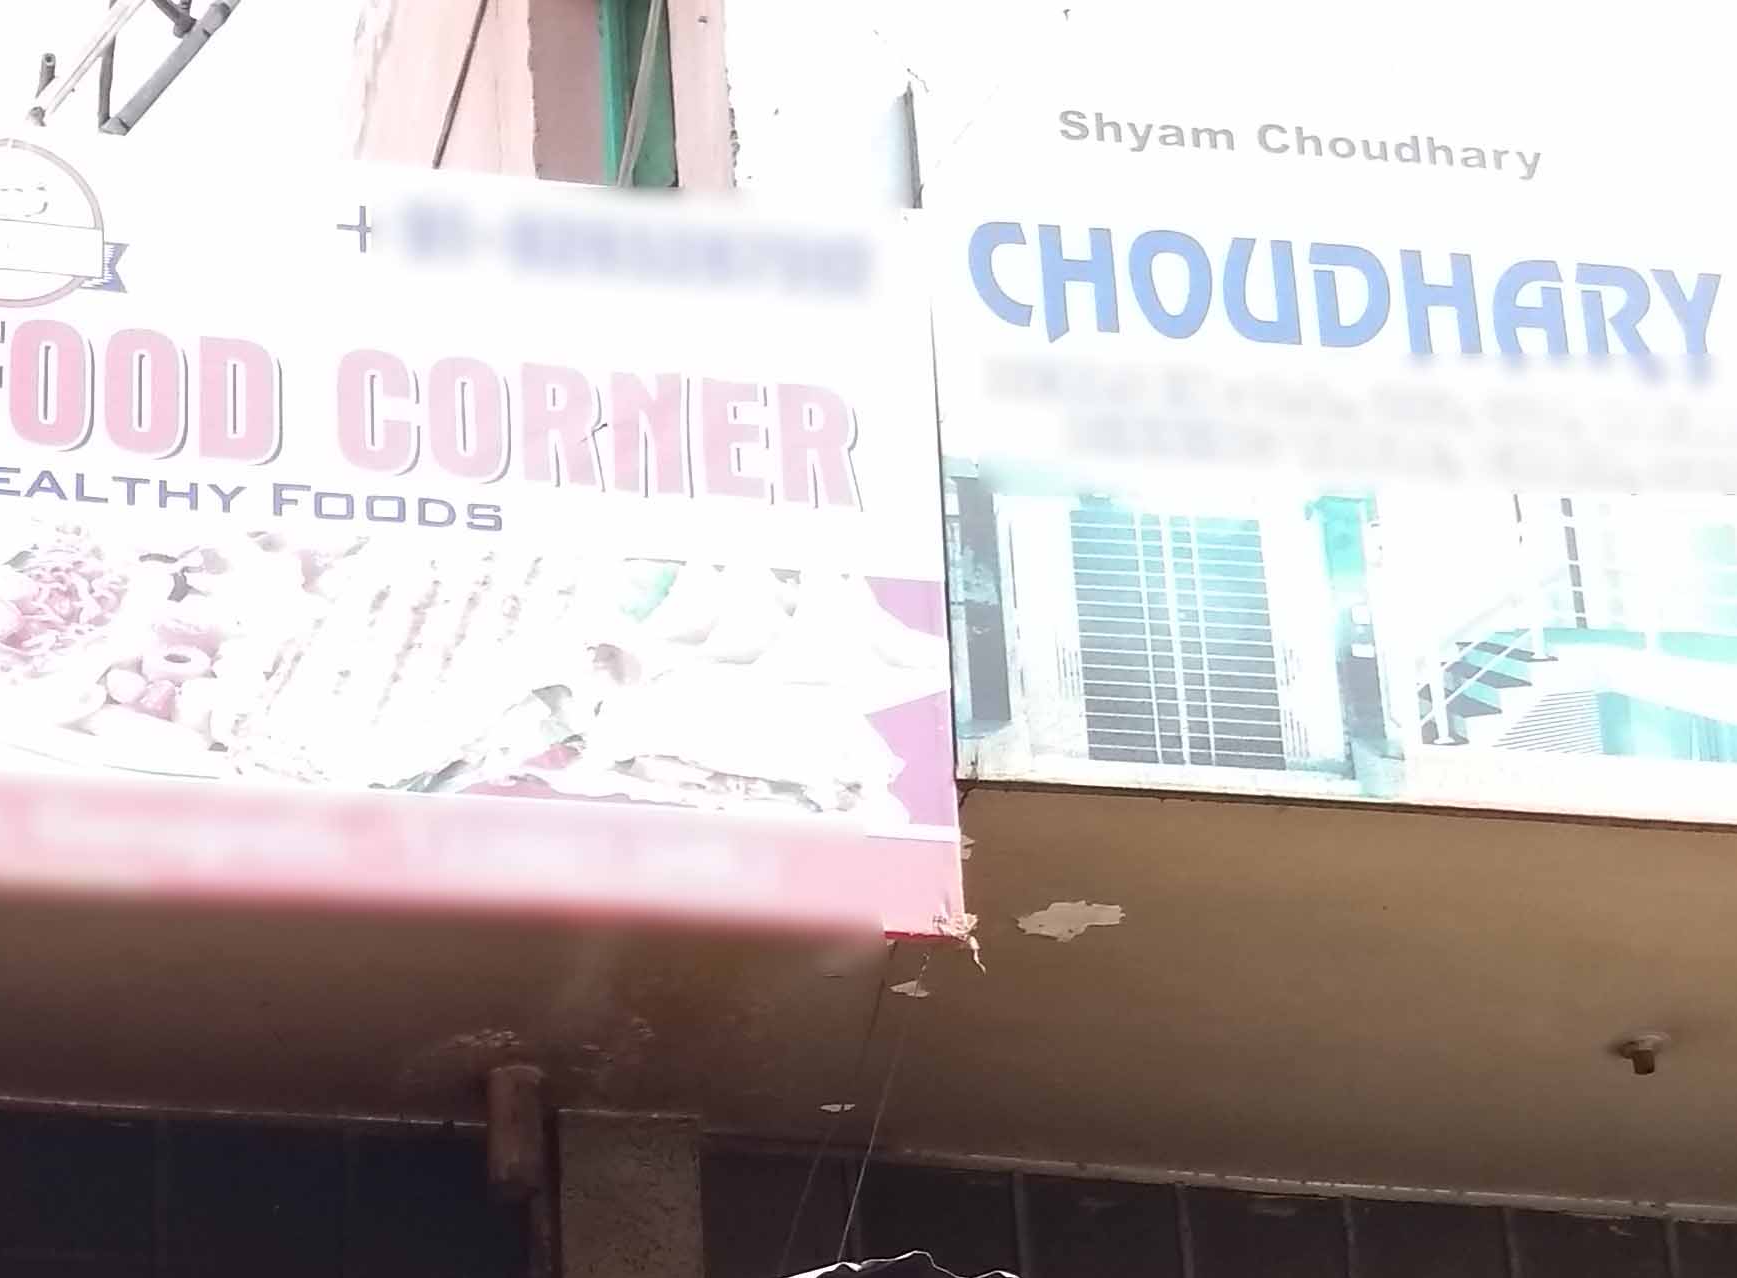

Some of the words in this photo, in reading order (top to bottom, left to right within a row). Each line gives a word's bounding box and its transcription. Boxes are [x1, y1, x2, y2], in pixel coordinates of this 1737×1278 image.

[1059, 109, 1236, 153] Shyam
[1257, 123, 1542, 180] Choudhary
[968, 220, 1721, 380] CHOUDHARY
[335, 348, 864, 512] CORNER
[271, 482, 503, 532] FOODS
